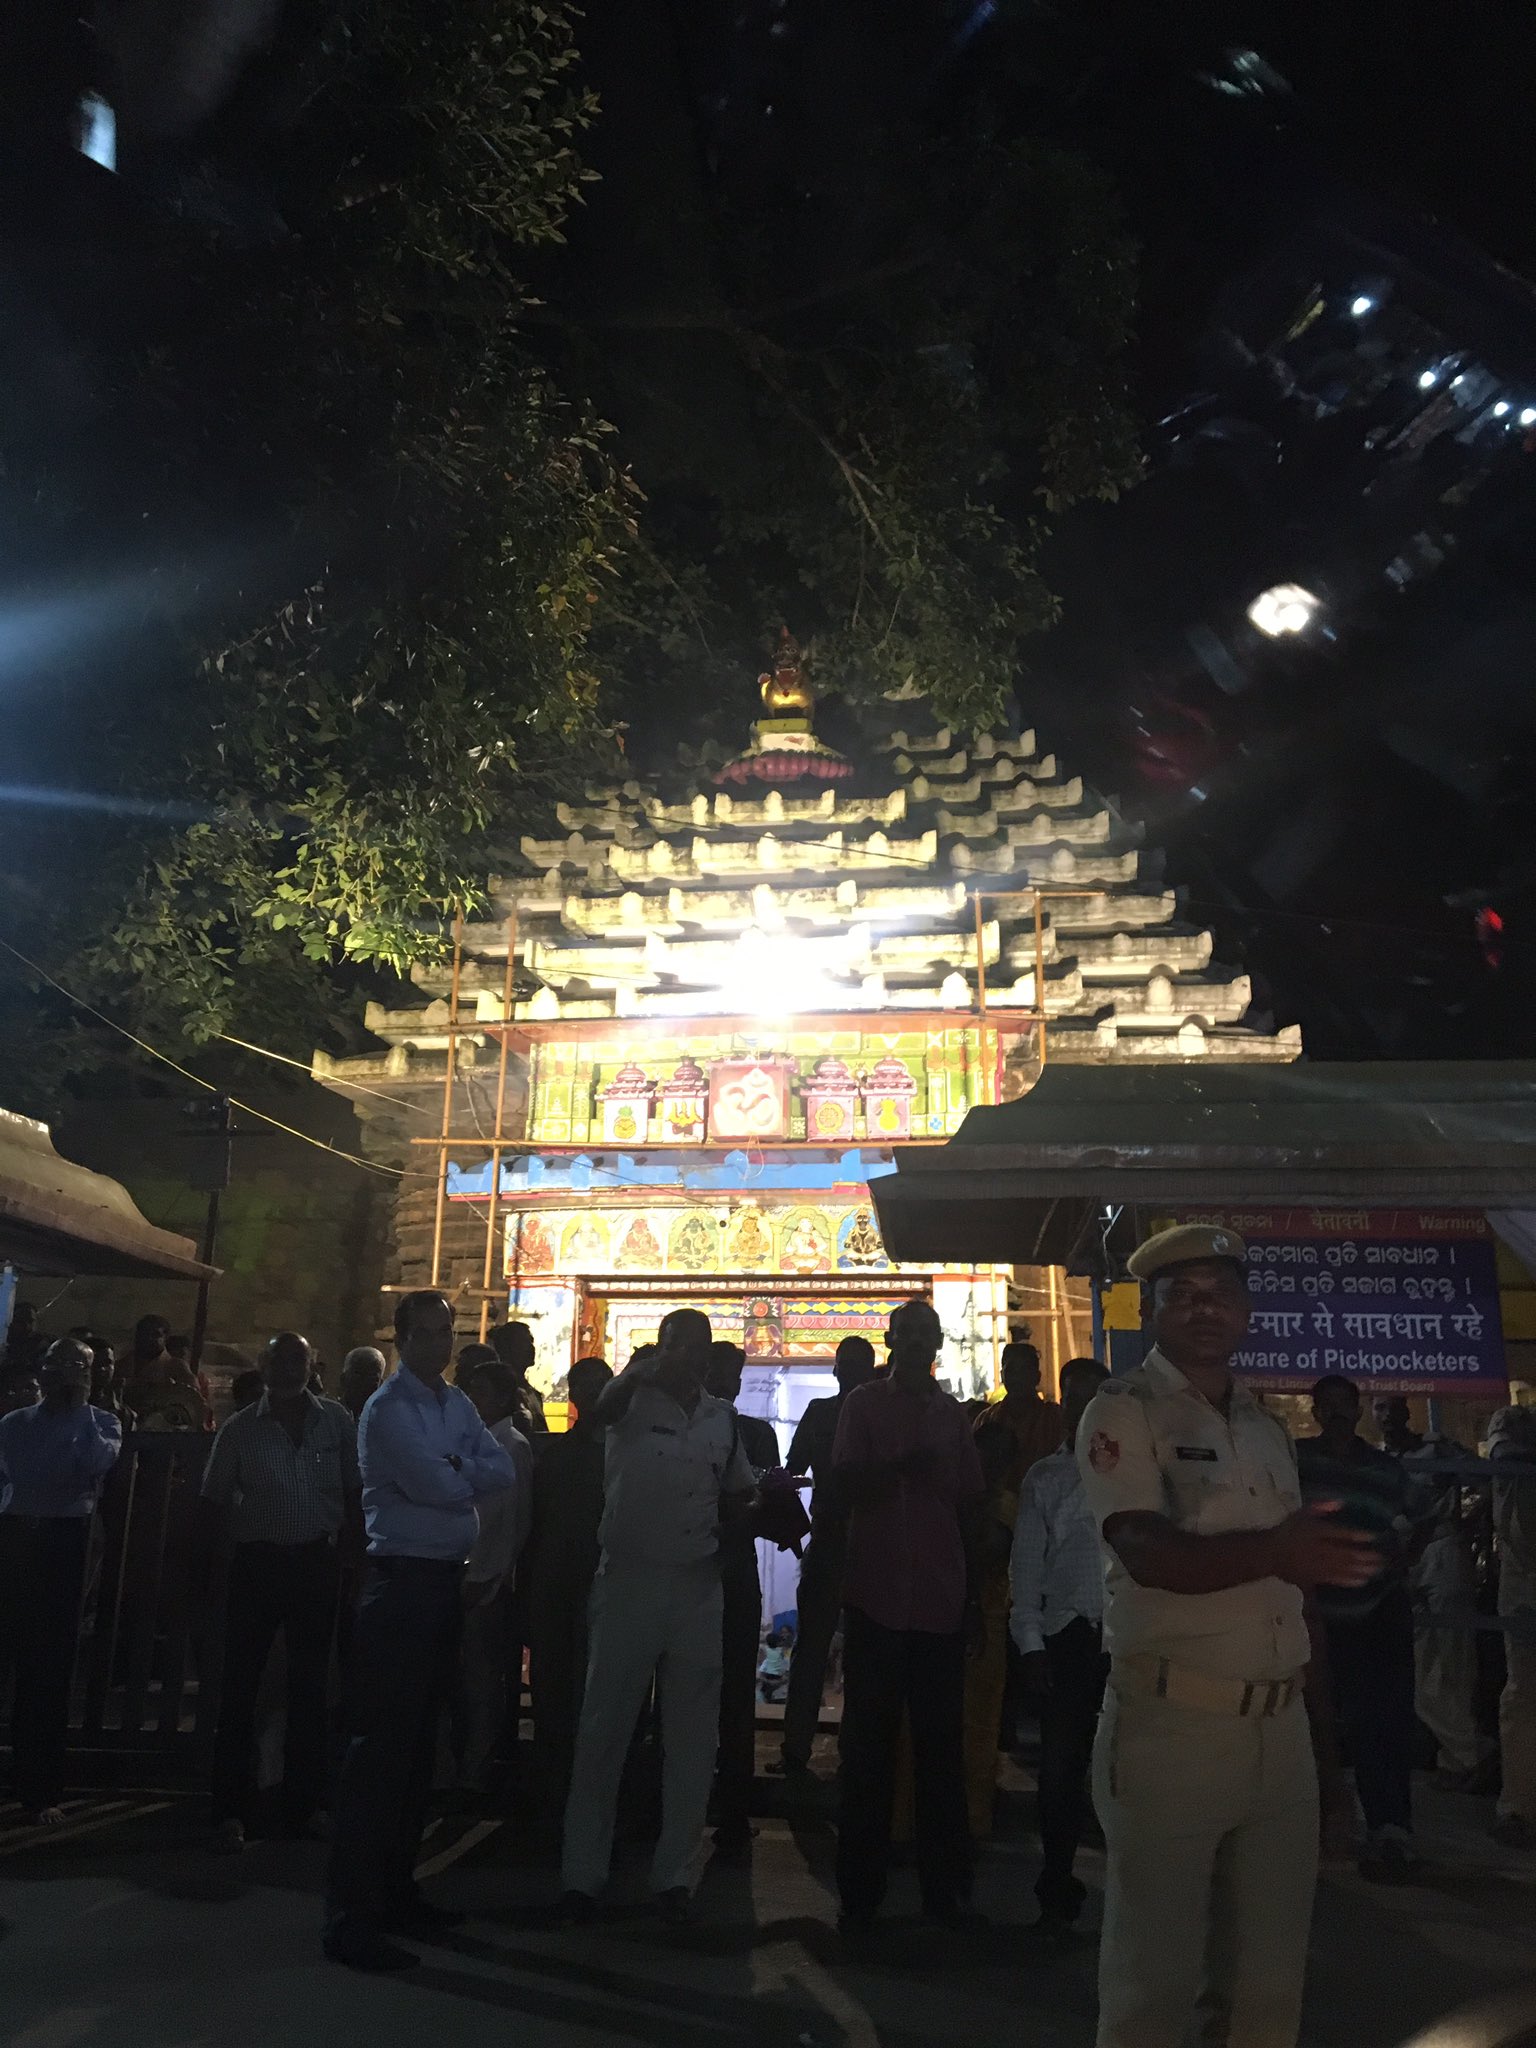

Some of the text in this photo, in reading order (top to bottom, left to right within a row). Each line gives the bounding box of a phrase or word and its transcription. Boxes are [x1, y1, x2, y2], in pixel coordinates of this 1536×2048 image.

[1419, 1214, 1486, 1233] Warning
[1239, 1245, 1319, 1265] କେଟମାର
[1325, 1240, 1359, 1267] ପ୍ରତି
[1301, 1270, 1336, 1297] ପ୍ରତି
[1247, 1302, 1485, 1341] टमार से सावधान रहे
[1227, 1348, 1480, 1375] eware of Pickpocketers
